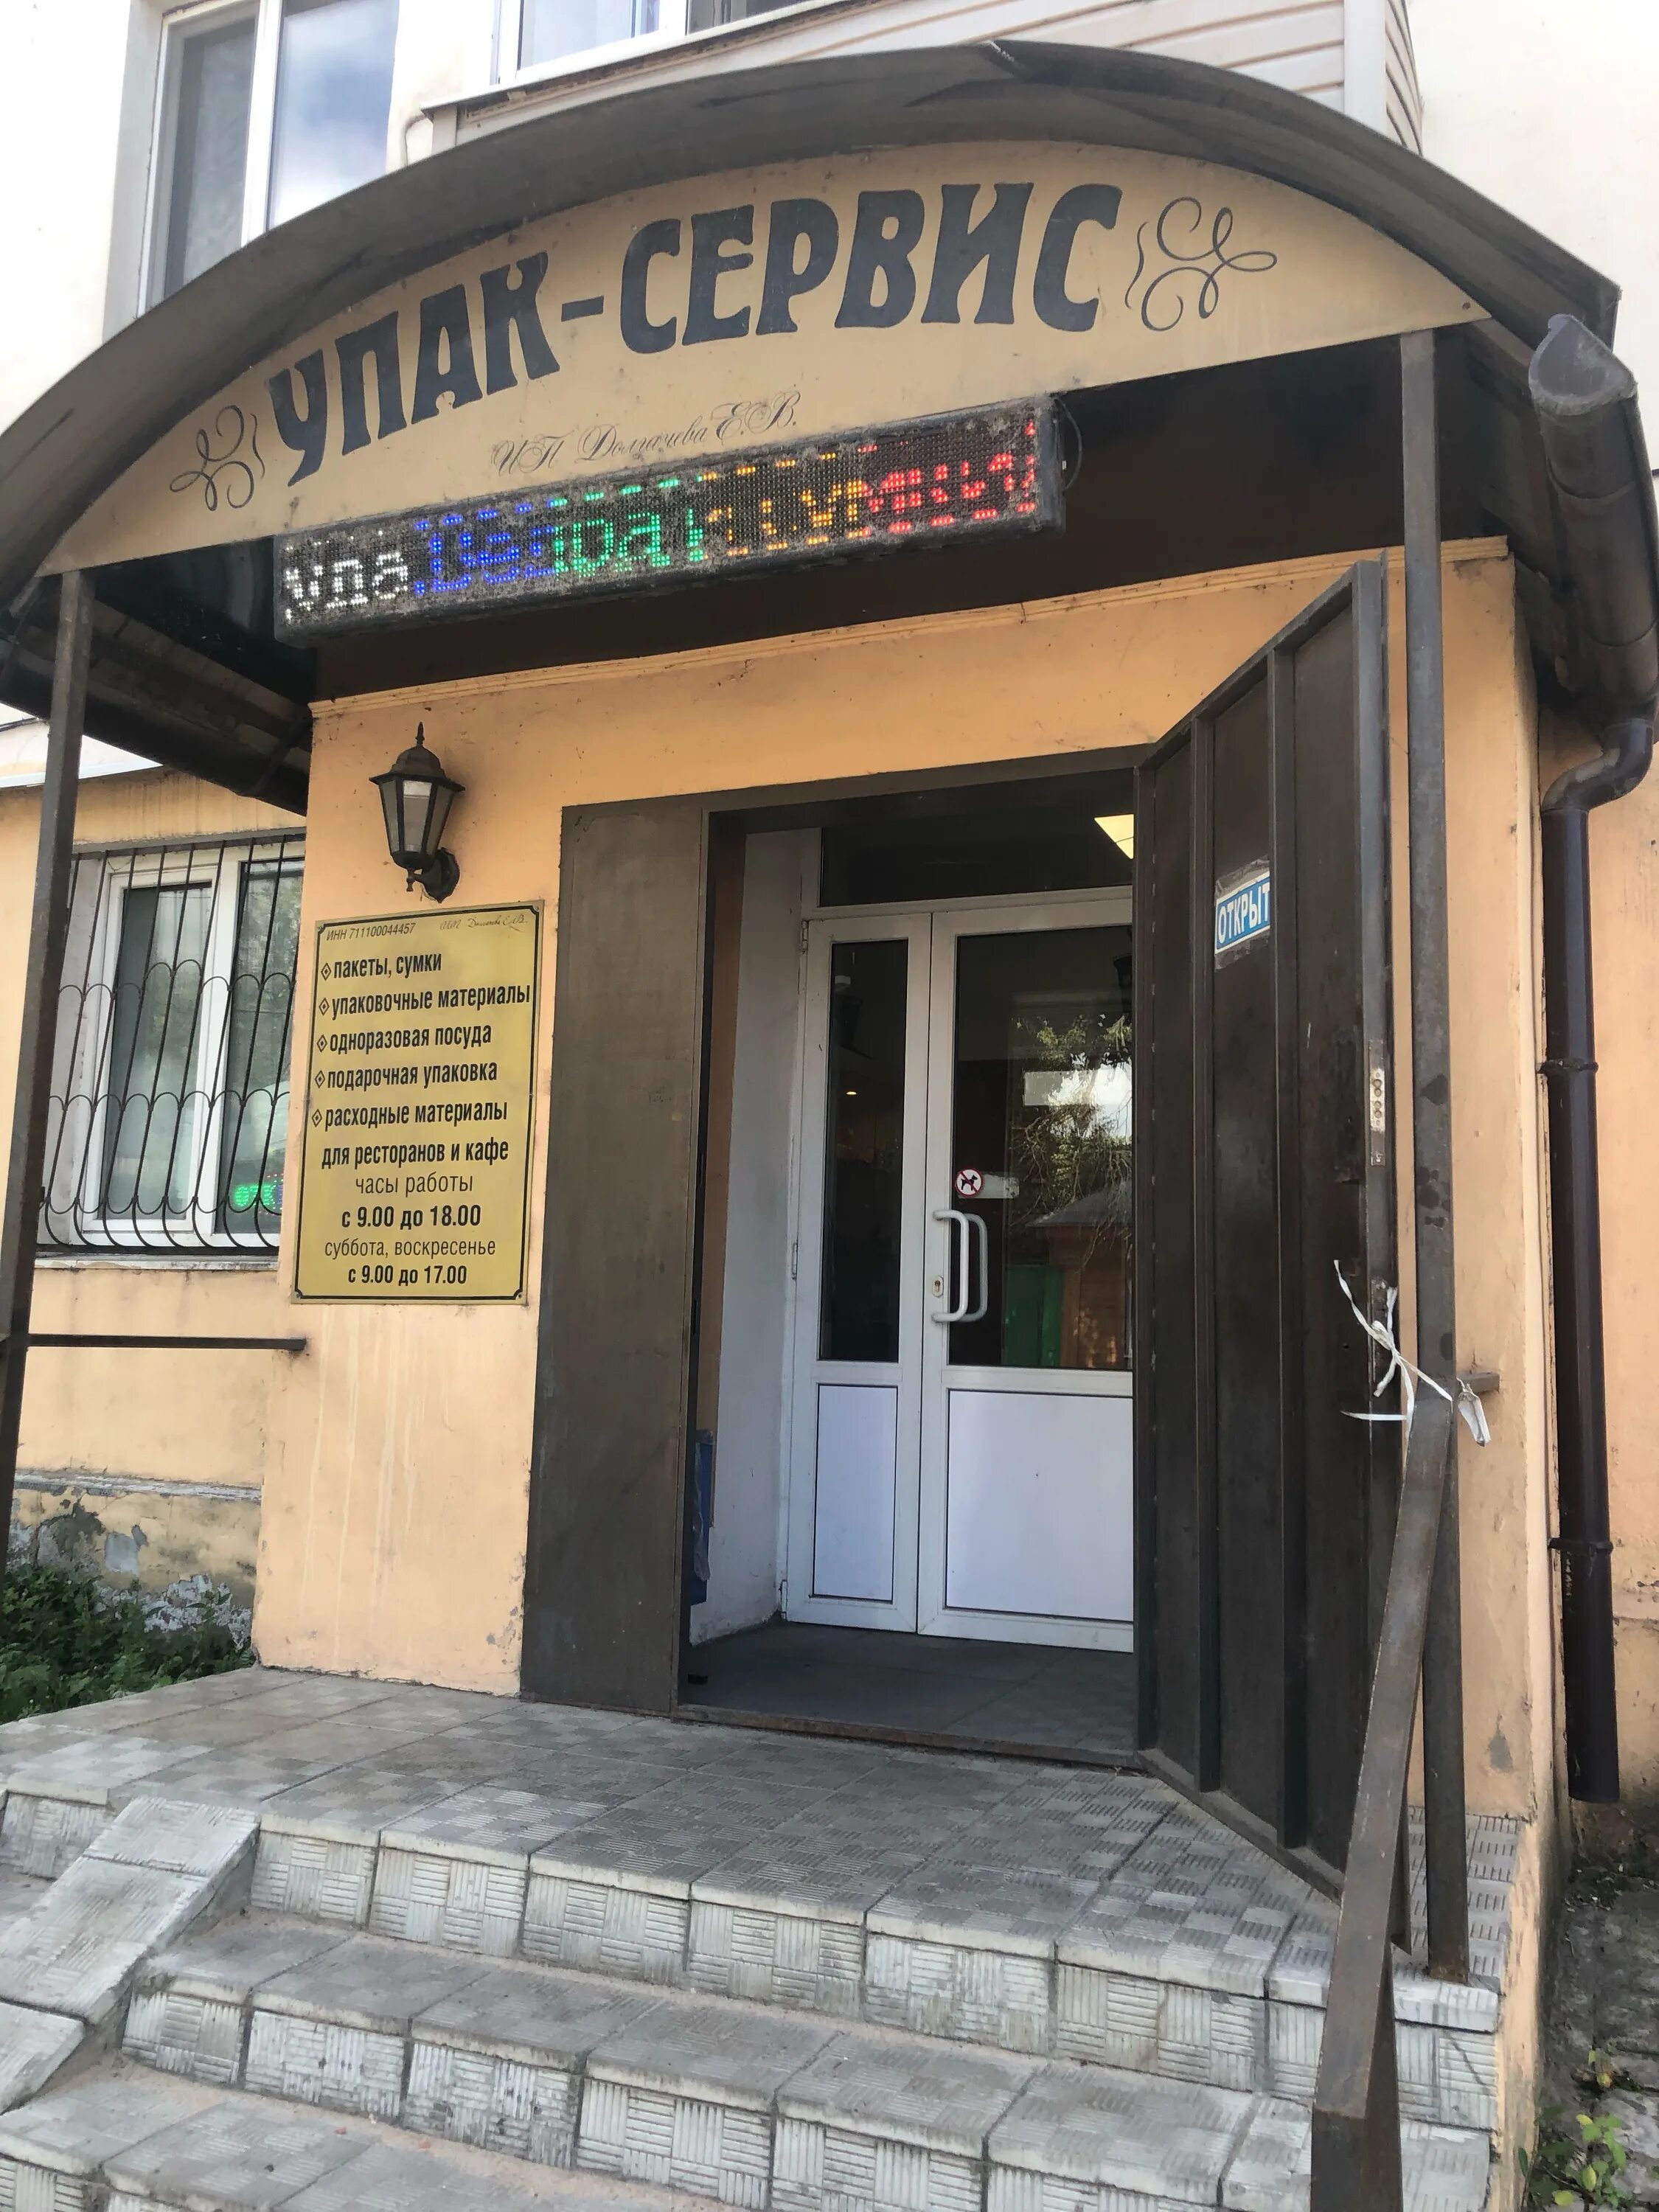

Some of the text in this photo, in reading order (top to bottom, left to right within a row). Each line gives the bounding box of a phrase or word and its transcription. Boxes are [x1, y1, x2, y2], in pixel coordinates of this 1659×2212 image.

[268, 182, 1122, 487] УПАК-СЕРВИС
[490, 429, 580, 476] ИП
[327, 923, 416, 941] ИНН 711100044457
[334, 953, 442, 978] пакеты, сумки
[332, 985, 530, 1020] упаковочные материалы
[330, 1024, 492, 1055] одноразовая посуда
[327, 1062, 498, 1091] подарочная упаковка
[325, 1102, 507, 1131] расходные материалы
[321, 1137, 509, 1169] для ресторанов и кафе
[355, 1172, 473, 1197] часы работы
[341, 1205, 481, 1230] с 9.00 до 18.00
[325, 1238, 495, 1259] суббота, воскресенье
[348, 1265, 467, 1287] с 9.00 до 17.00
